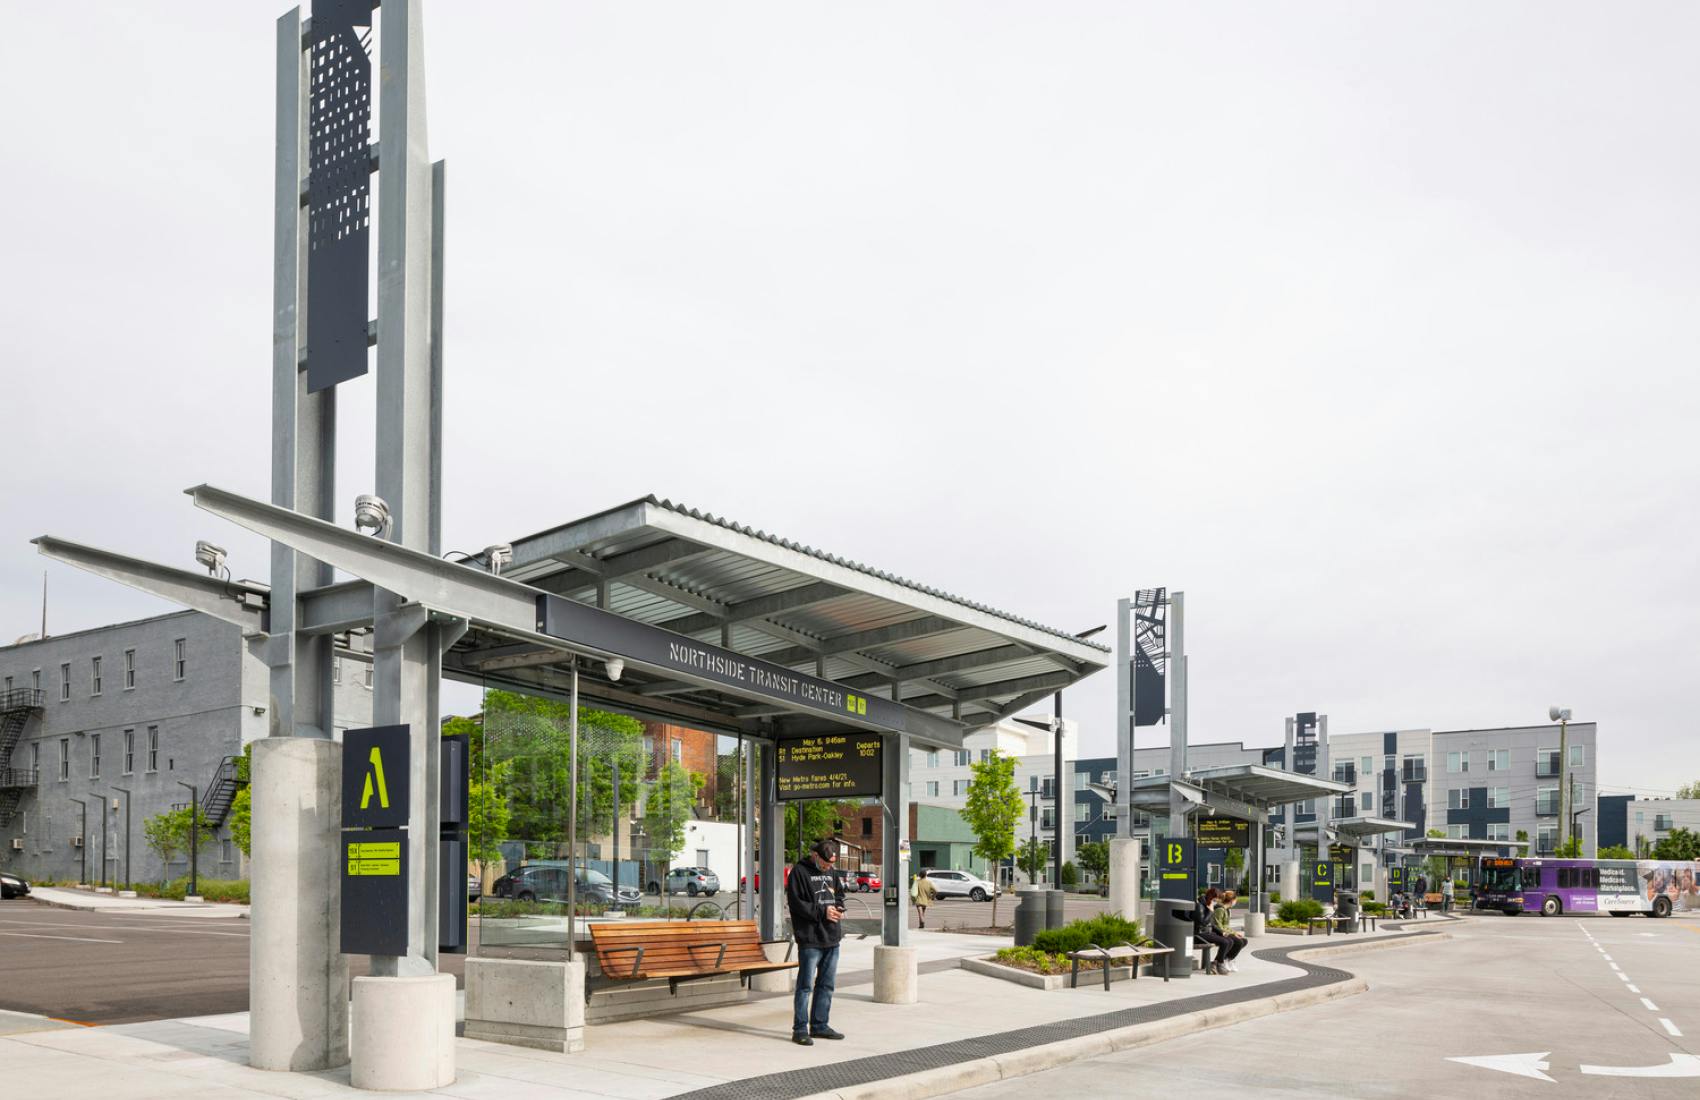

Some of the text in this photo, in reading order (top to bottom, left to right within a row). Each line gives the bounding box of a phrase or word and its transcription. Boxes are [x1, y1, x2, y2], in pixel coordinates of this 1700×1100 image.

[670, 642, 746, 680] NORTHSIDE
[749, 666, 799, 695] TRANSIT
[800, 682, 842, 708] CENTER
[791, 746, 824, 754] Destination
[856, 741, 881, 750] Departs
[791, 754, 806, 762] Hyde
[808, 752, 844, 760] Park-Oakley
[359, 746, 390, 810] A
[832, 780, 842, 788] for
[1168, 843, 1183, 865] B
[1316, 863, 1327, 876] C
[1393, 869, 1401, 878] D
